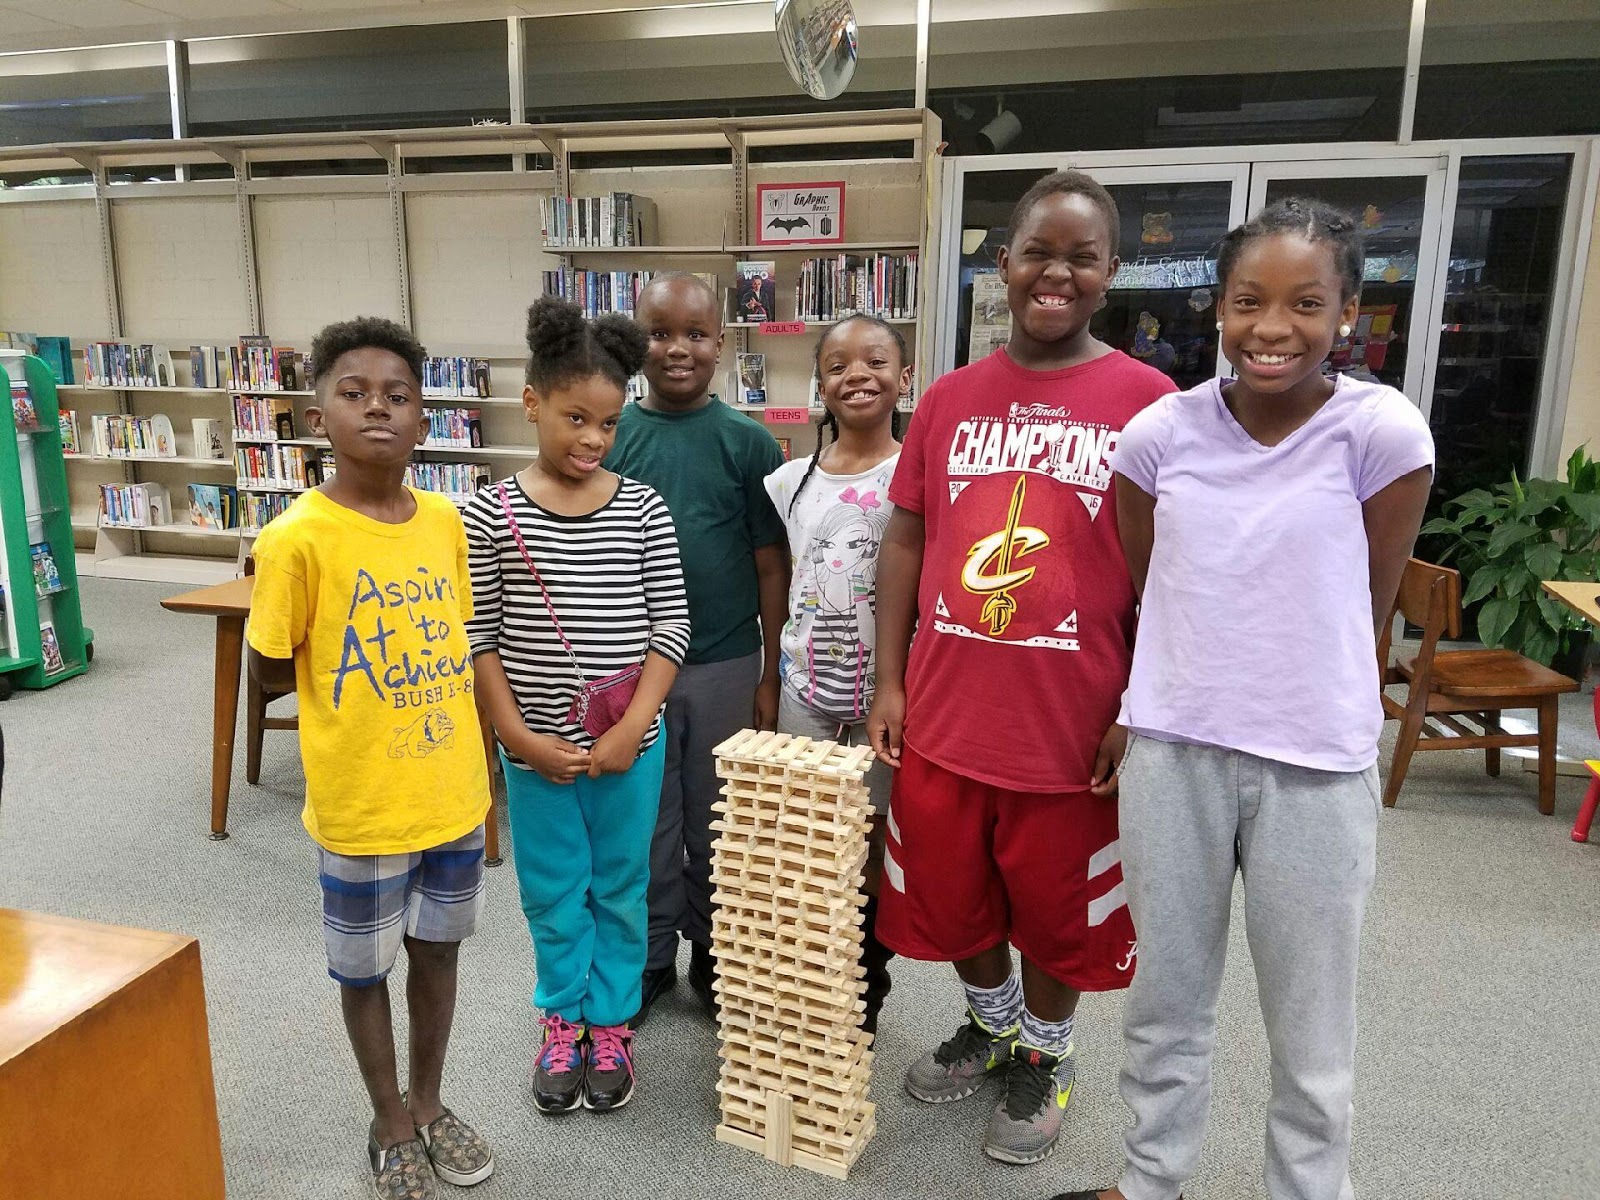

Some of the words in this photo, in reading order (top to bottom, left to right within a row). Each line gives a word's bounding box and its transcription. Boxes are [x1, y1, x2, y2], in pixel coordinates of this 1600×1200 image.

[765, 324, 800, 334] ADULTS
[770, 411, 801, 421] TEENS
[1029, 402, 1072, 418] Finals
[948, 466, 989, 474] CLEVELAND
[1059, 474, 1106, 489] CAVALIERS
[951, 483, 961, 494] 20
[1089, 497, 1099, 509] 16
[348, 566, 456, 622] Aspir
[416, 614, 450, 643] to
[392, 685, 443, 709] BUSH
